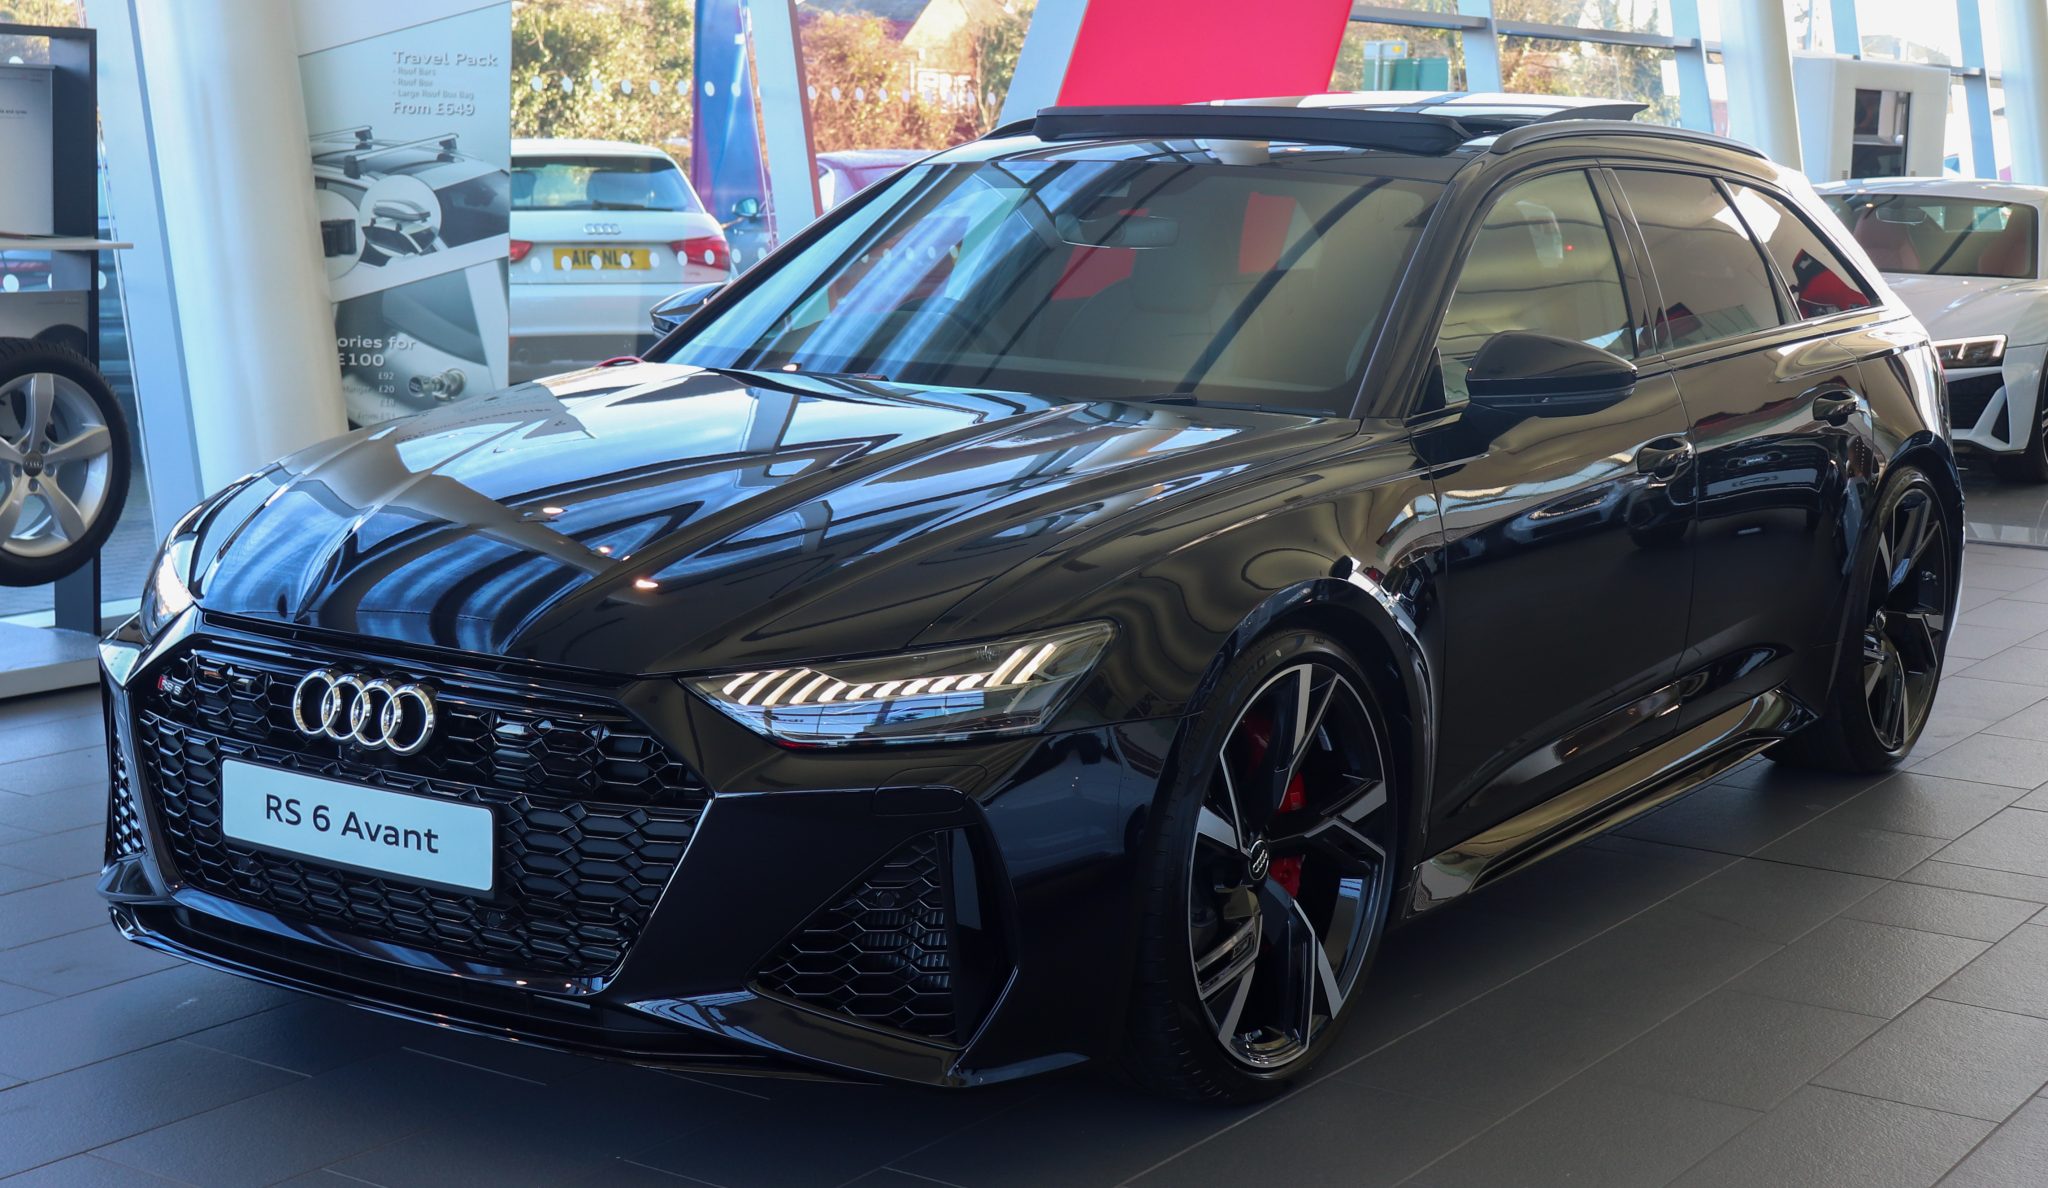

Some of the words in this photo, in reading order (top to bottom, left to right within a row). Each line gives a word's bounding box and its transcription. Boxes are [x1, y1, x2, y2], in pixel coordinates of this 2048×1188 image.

[392, 51, 449, 65] Travel
[455, 53, 499, 67] Pack
[392, 102, 431, 115] From
[387, 336, 416, 350] for
[266, 793, 302, 826] RS
[312, 804, 331, 832] 6
[341, 811, 439, 854] Avant
